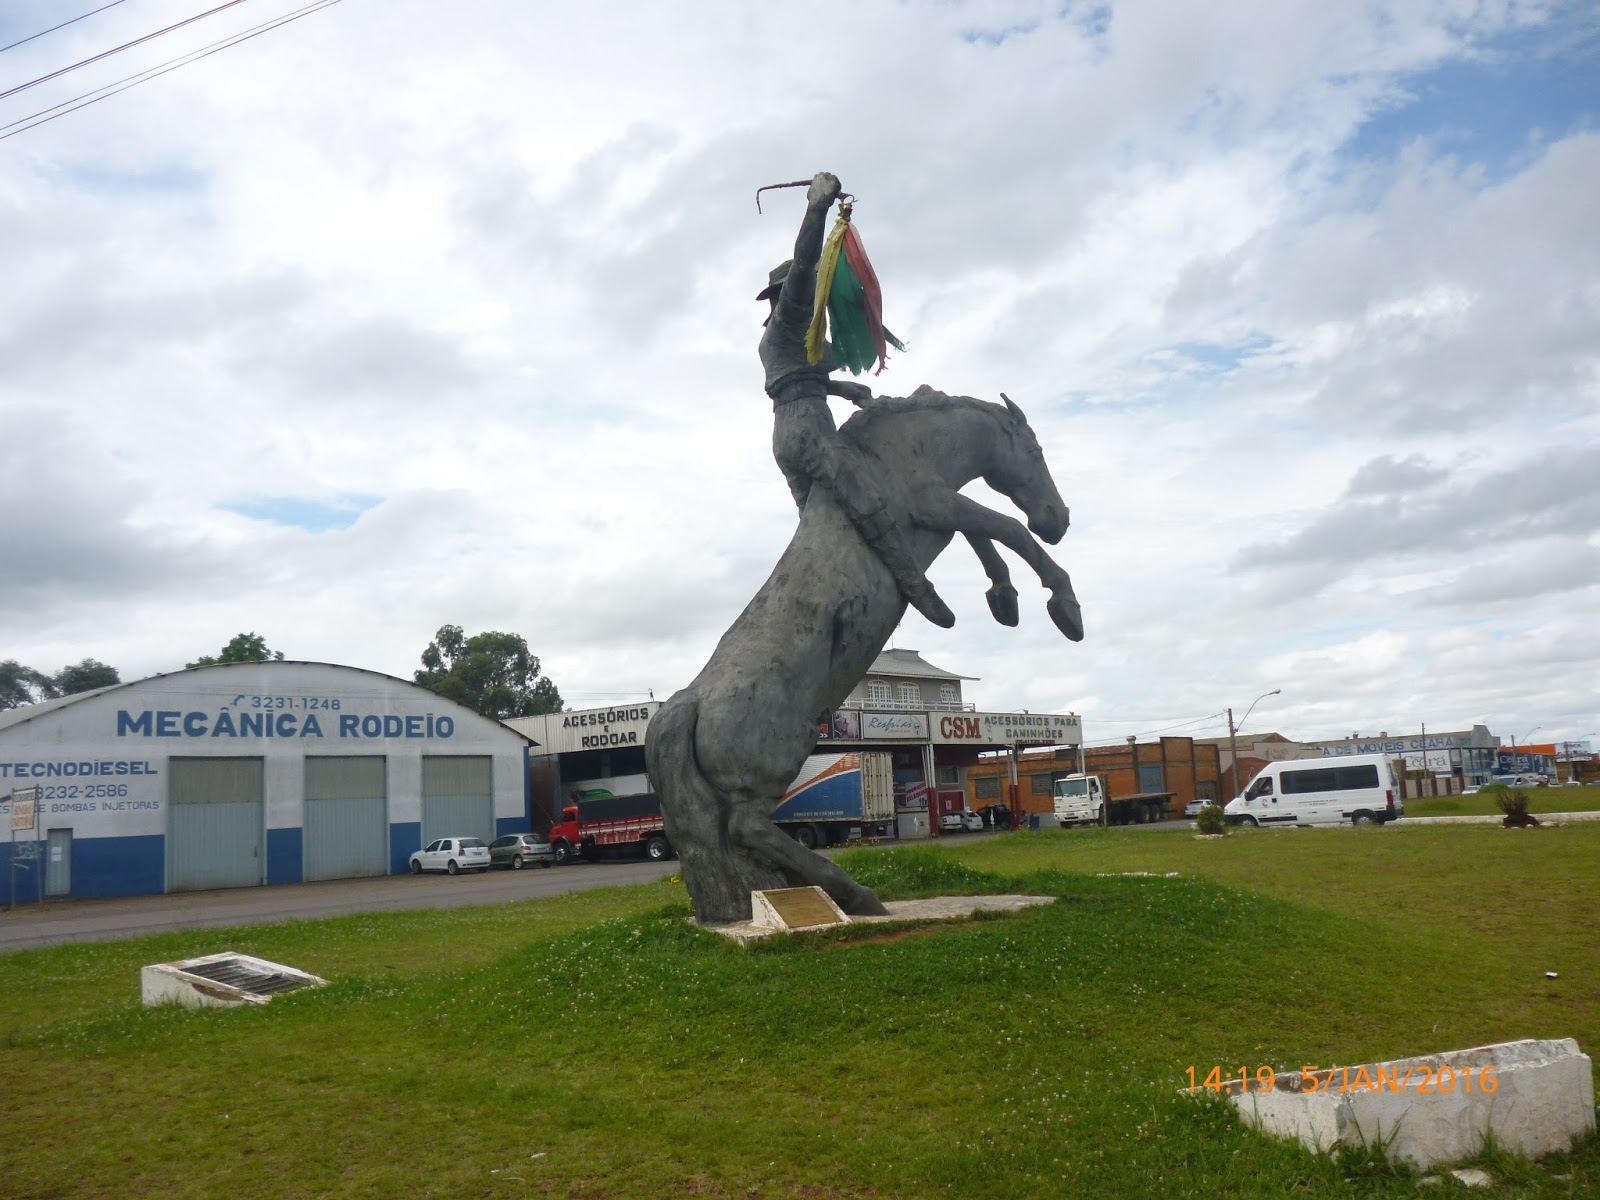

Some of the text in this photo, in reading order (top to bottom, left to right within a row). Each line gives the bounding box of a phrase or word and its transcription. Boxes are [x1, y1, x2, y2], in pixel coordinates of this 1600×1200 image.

[117, 707, 454, 738] MECÂNICA RODEIO
[563, 707, 649, 728] ACESSÓRIOS
[940, 715, 1077, 739] CSM ACESSÓRIOS PARA
[1005, 727, 1063, 738] CAMINHÕES
[581, 731, 637, 748] RODOAR
[0, 760, 158, 778] TECNODIESEL
[52, 802, 96, 813] BOMBAS
[102, 801, 159, 811] INJETORAS
